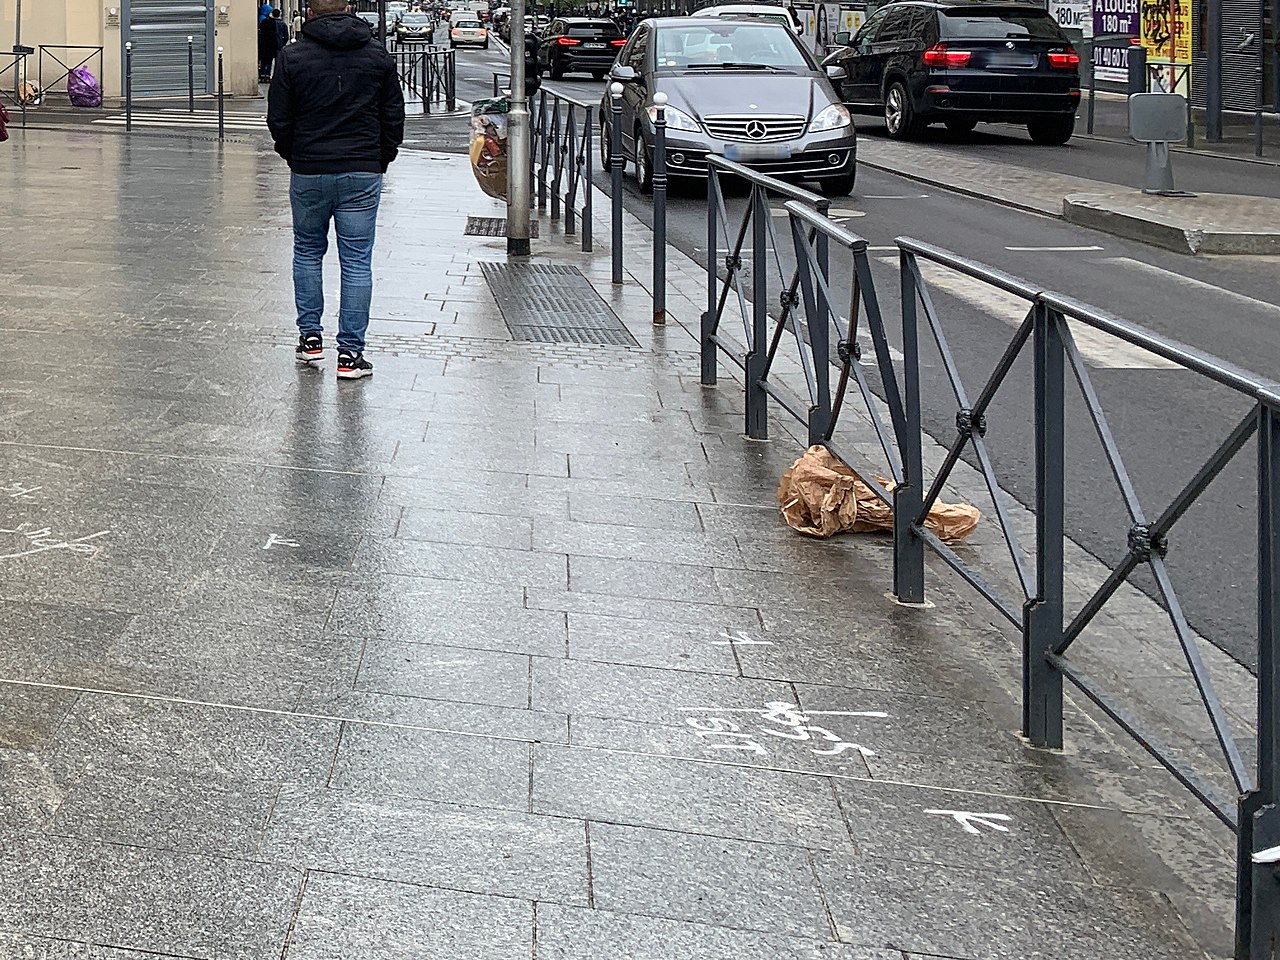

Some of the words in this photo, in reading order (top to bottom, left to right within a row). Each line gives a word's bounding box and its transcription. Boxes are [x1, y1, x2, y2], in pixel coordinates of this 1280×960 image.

[1056, 7, 1072, 25] 180
[1101, 14, 1118, 32] 180
[1094, 46, 1102, 65] 01
[1103, 47, 1111, 66] 40
[1112, 48, 1120, 67] 60
